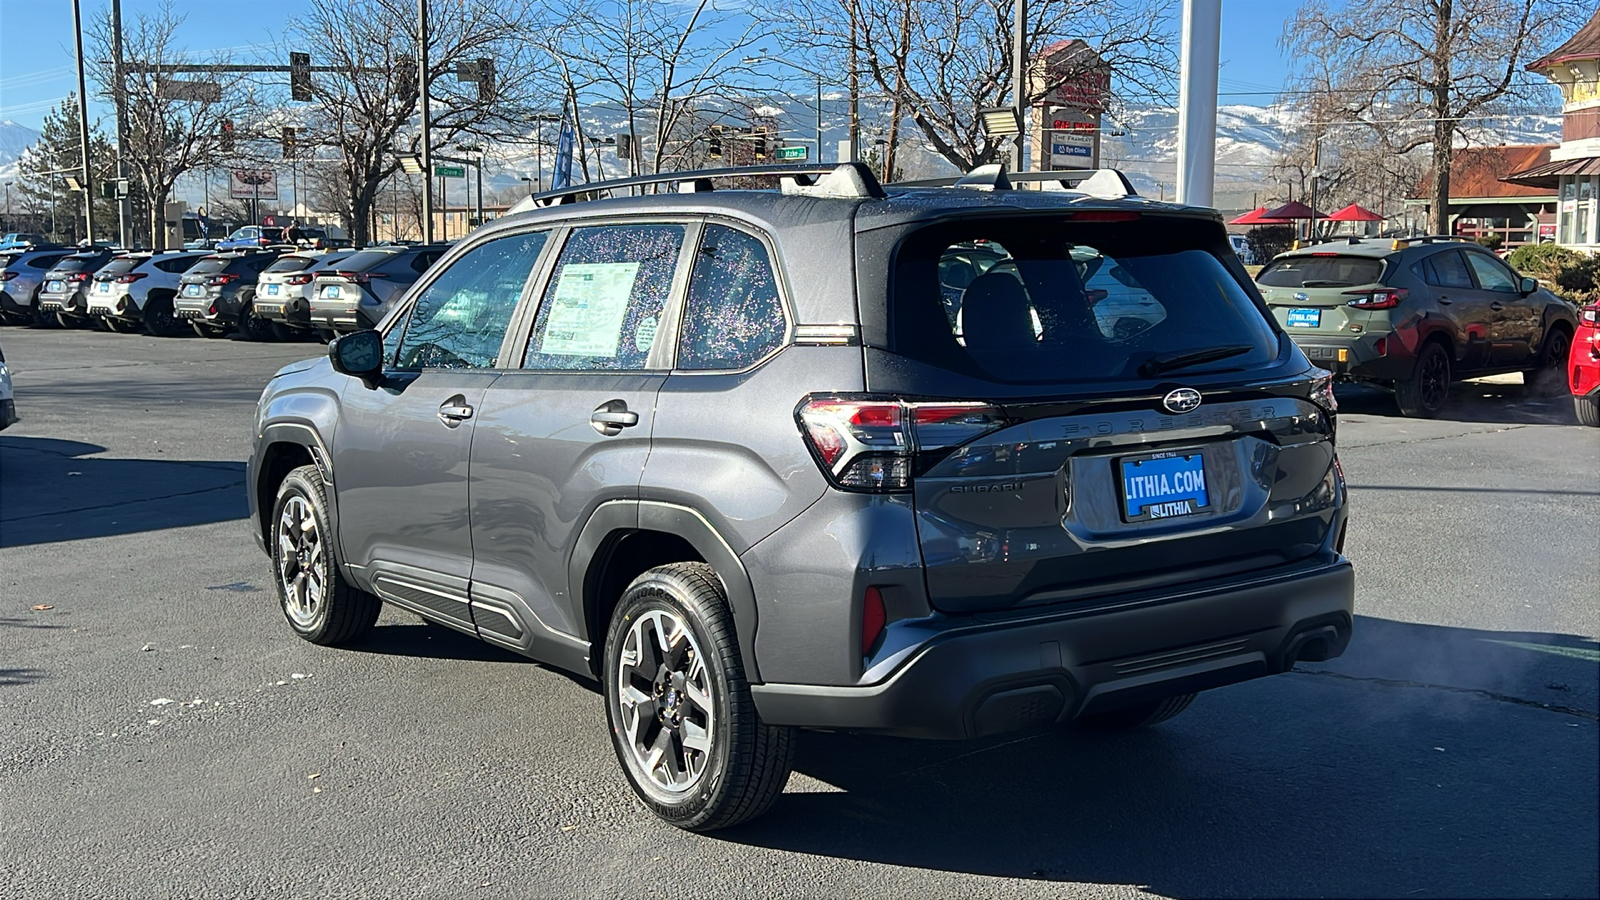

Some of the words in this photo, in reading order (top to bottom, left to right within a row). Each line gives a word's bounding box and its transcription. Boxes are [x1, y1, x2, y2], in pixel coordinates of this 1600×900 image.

[1061, 406, 1276, 438] FORESTER
[950, 482, 1025, 494] SUBARU
[1125, 469, 1205, 500] LITHIA.COM
[1159, 501, 1192, 517] LITHIA
